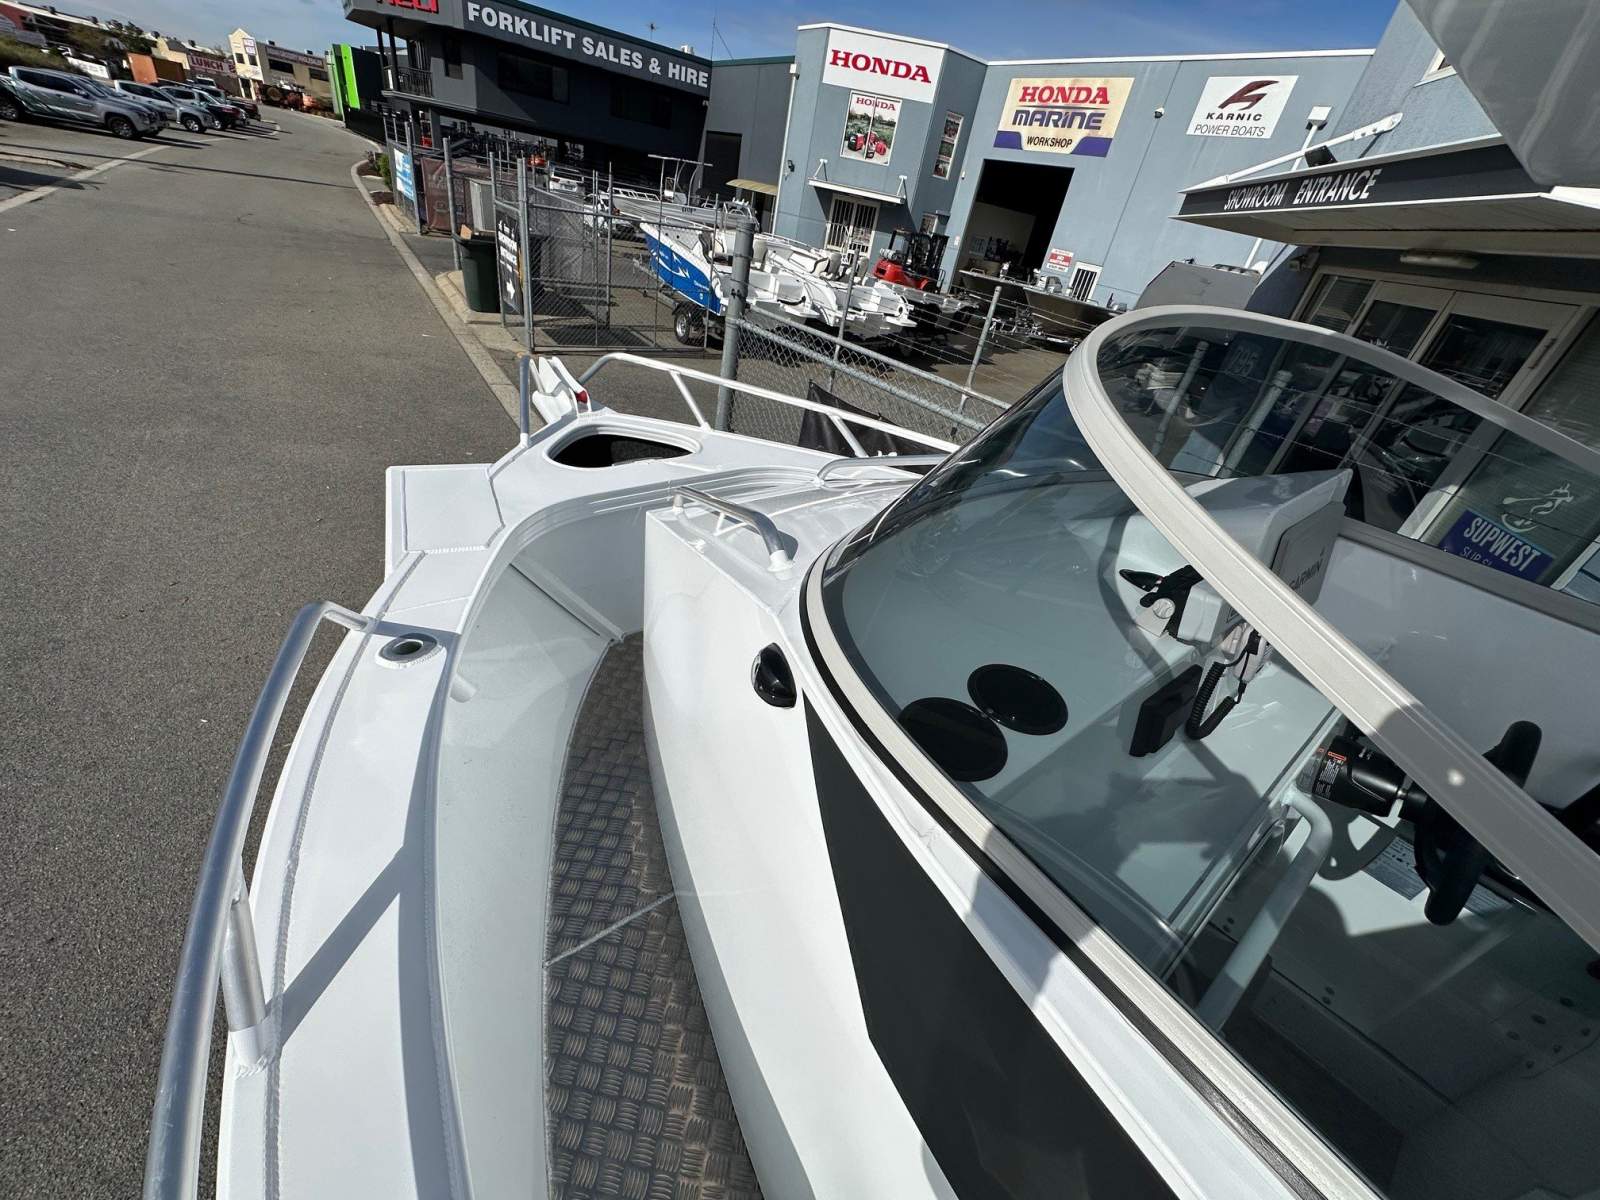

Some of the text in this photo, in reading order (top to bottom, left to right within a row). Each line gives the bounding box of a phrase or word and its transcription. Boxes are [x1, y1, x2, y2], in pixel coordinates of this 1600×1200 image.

[468, 3, 710, 89] FORKLIFT SALES & HIRE
[191, 54, 224, 72] LUNCH
[829, 49, 931, 83] HONDA
[855, 96, 896, 112] HONDA
[1018, 85, 1110, 105] HONDA
[1011, 109, 1105, 131] MARINE
[1206, 111, 1263, 122] KARNIC
[1193, 123, 1266, 138] POWER BOATS
[1026, 134, 1073, 149] WORKSHOP
[1224, 168, 1383, 210] SHOWROOM ENTRANCE
[1463, 517, 1542, 571] SUPWEST
